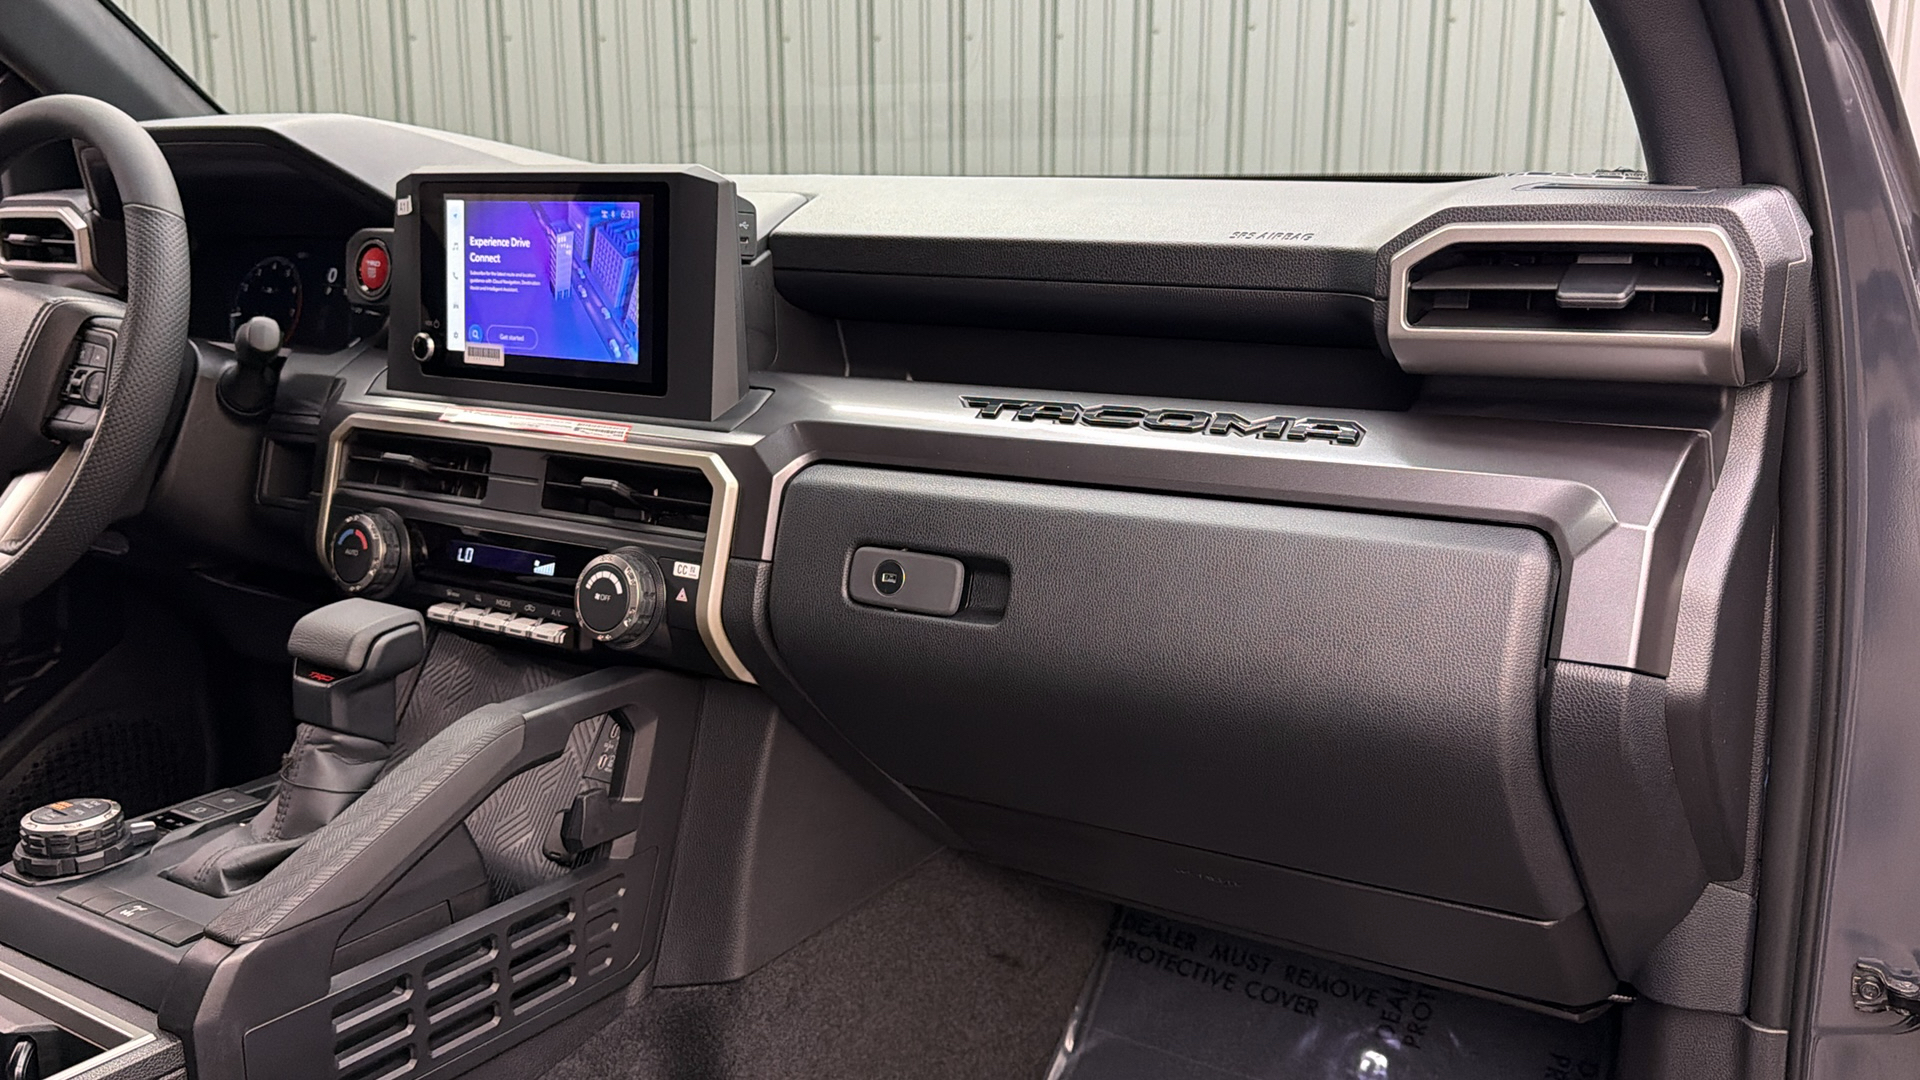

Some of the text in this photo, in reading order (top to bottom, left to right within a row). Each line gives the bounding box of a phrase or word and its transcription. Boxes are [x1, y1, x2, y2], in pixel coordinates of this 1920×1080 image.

[469, 235, 531, 249] Experience Drive
[1229, 231, 1315, 241] SRS AIRBAG
[469, 252, 502, 264] Connect
[327, 267, 339, 284] 0
[958, 395, 1365, 447] TACOMA
[677, 564, 688, 575] CC
[600, 593, 612, 602] OFF
[551, 609, 561, 617] A/C
[1122, 911, 1197, 951] DEALER
[1208, 944, 1273, 975] MUST
[1284, 965, 1380, 1007] REMOVE
[1111, 935, 1319, 1018] PROTECTIVE COVER
